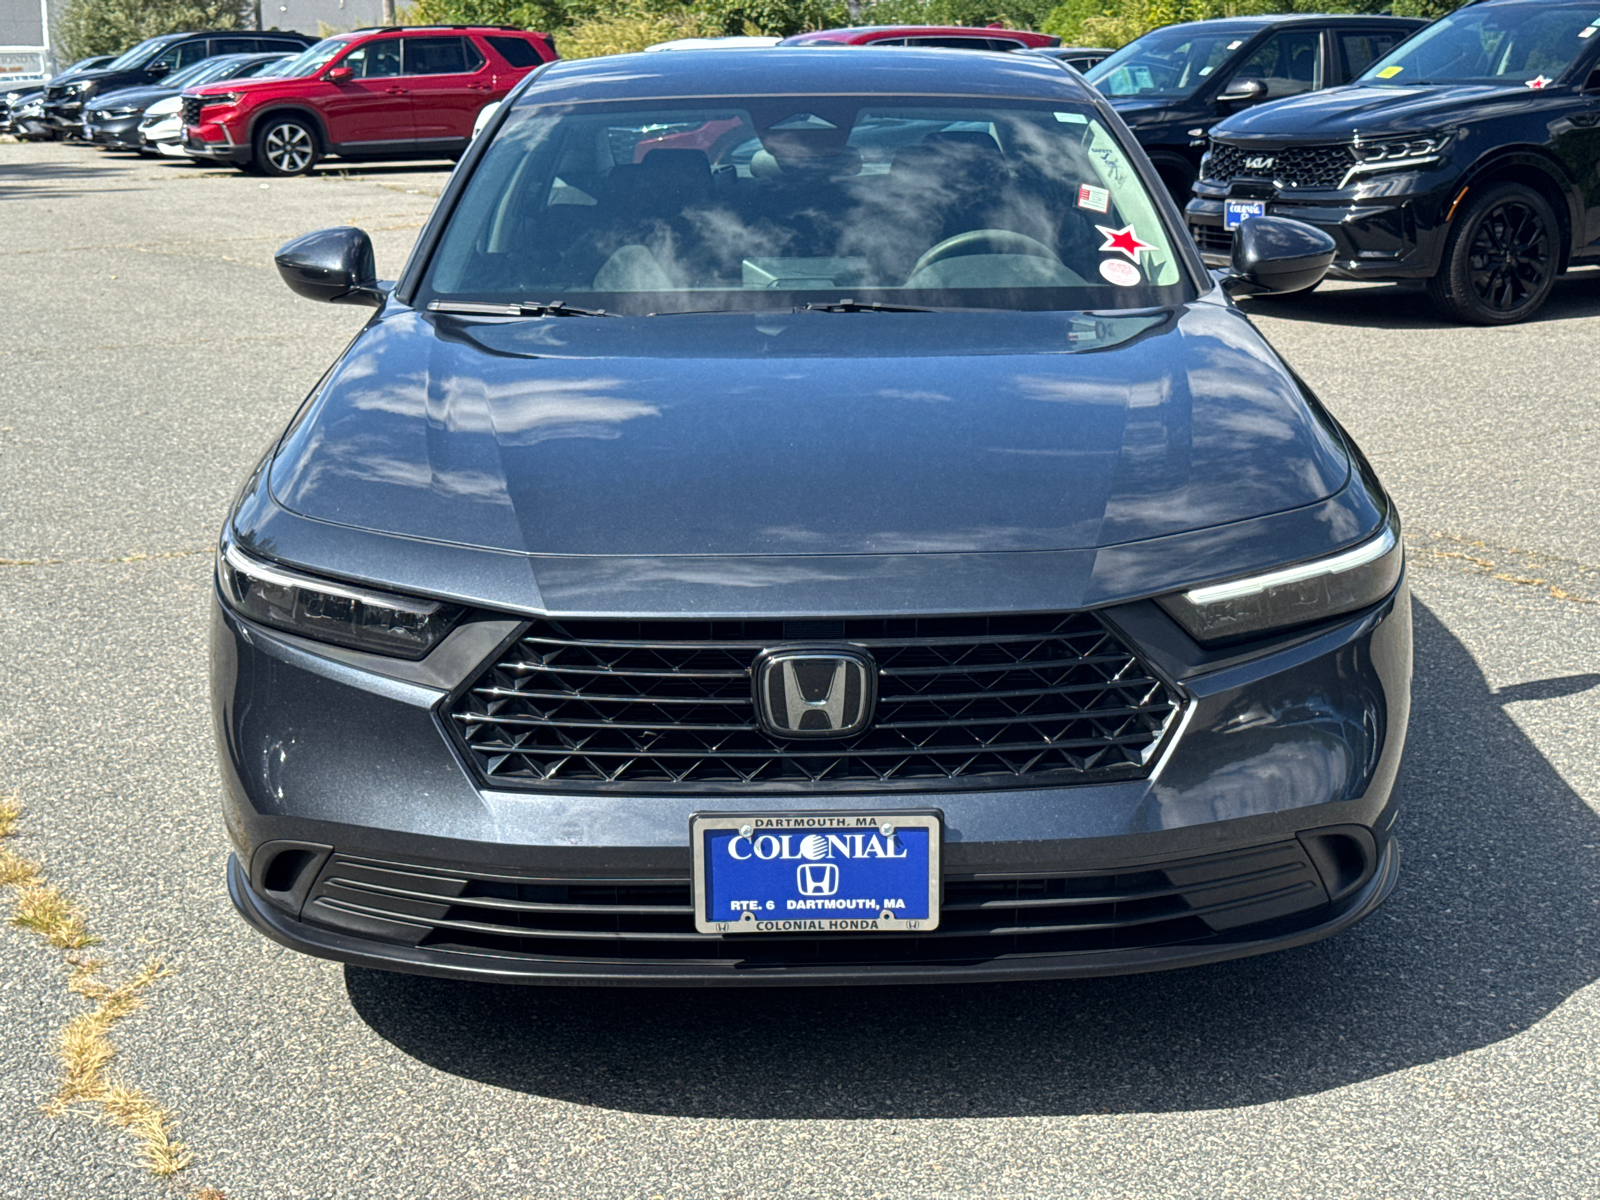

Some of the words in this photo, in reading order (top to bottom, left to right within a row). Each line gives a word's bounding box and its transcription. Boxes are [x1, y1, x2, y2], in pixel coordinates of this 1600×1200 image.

[754, 817, 850, 828] DARTMOUTH,
[855, 817, 878, 827] MA
[727, 834, 908, 860] COLONIAL
[730, 900, 762, 911] RTE.
[765, 900, 776, 910] 6
[786, 899, 880, 911] DARTMOUTH,
[883, 898, 906, 909] MA
[756, 921, 826, 931] COLONIAL
[829, 920, 879, 930] HONDA
